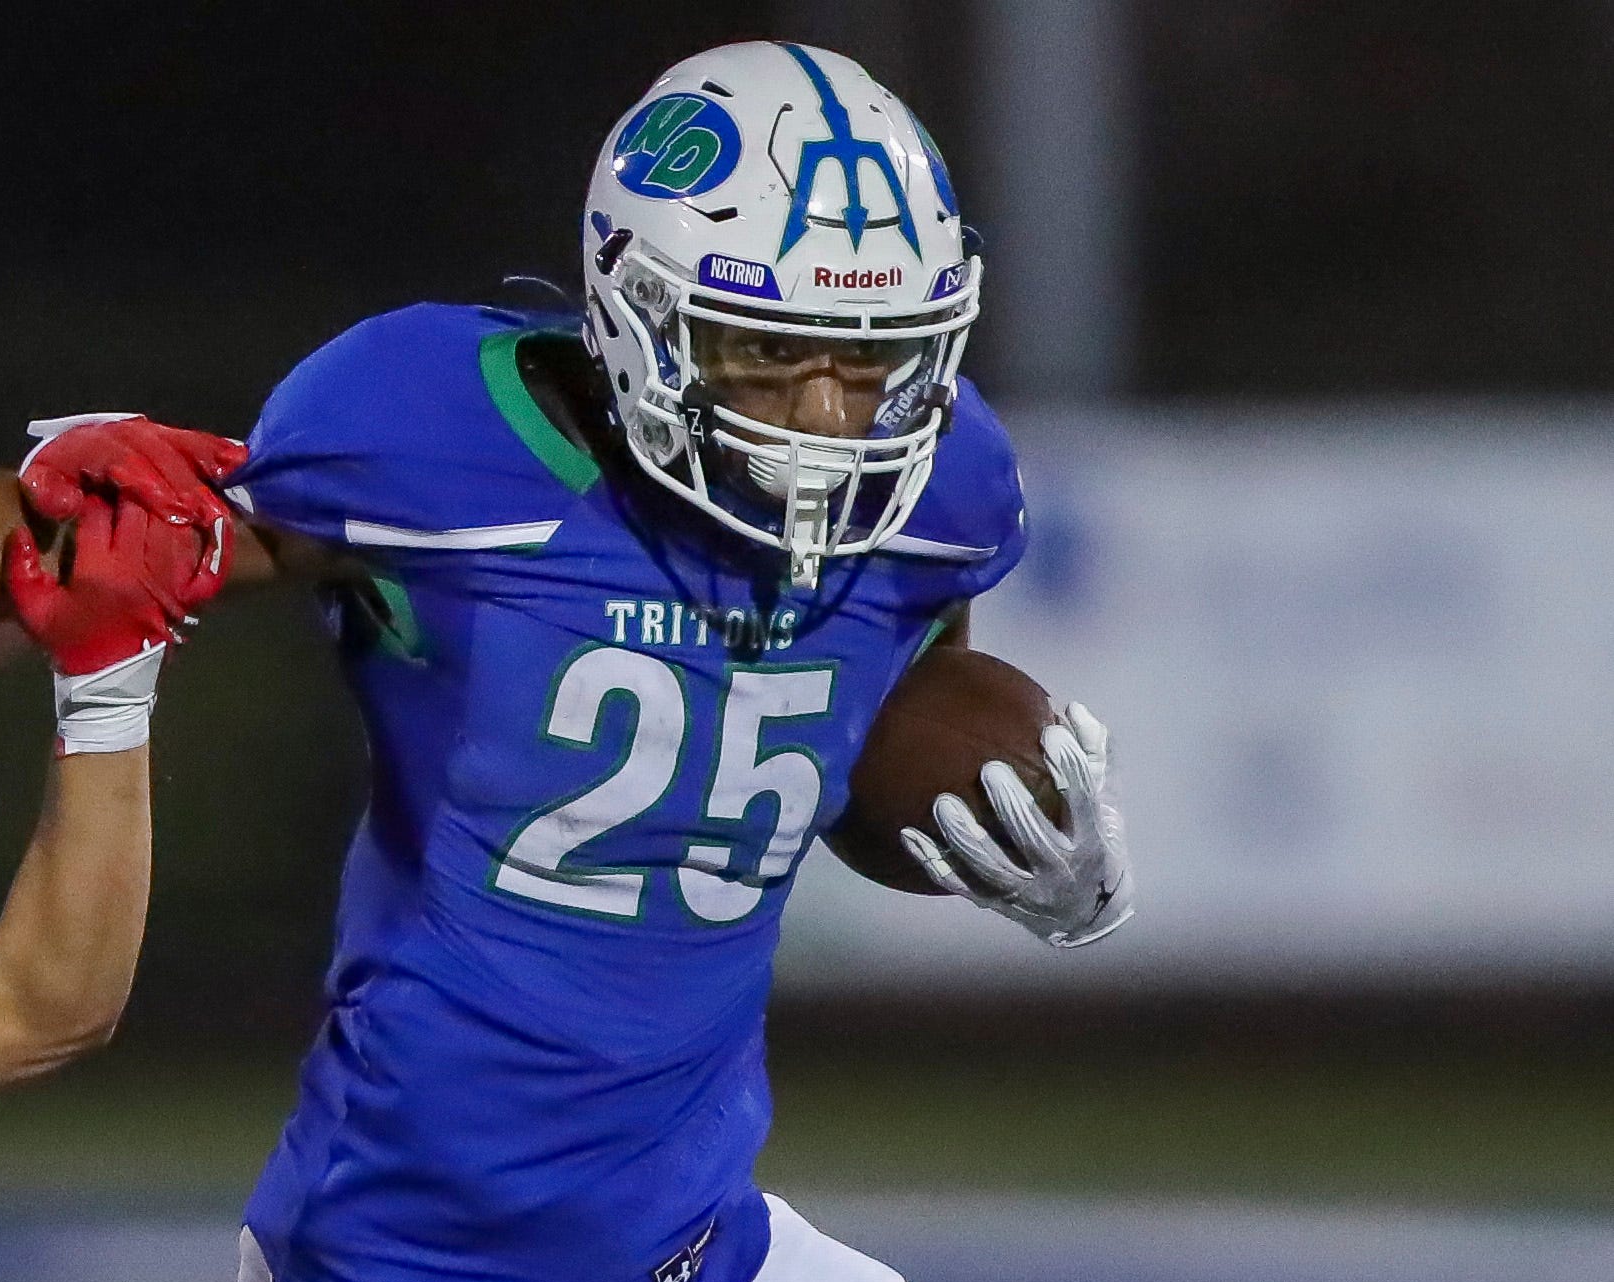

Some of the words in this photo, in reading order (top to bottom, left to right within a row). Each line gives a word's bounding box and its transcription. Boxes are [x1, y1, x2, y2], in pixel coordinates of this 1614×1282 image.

[710, 256, 765, 288] NXTRND
[814, 266, 903, 289] Riddell
[604, 600, 797, 651] TRITOS
[492, 644, 836, 924] 25
